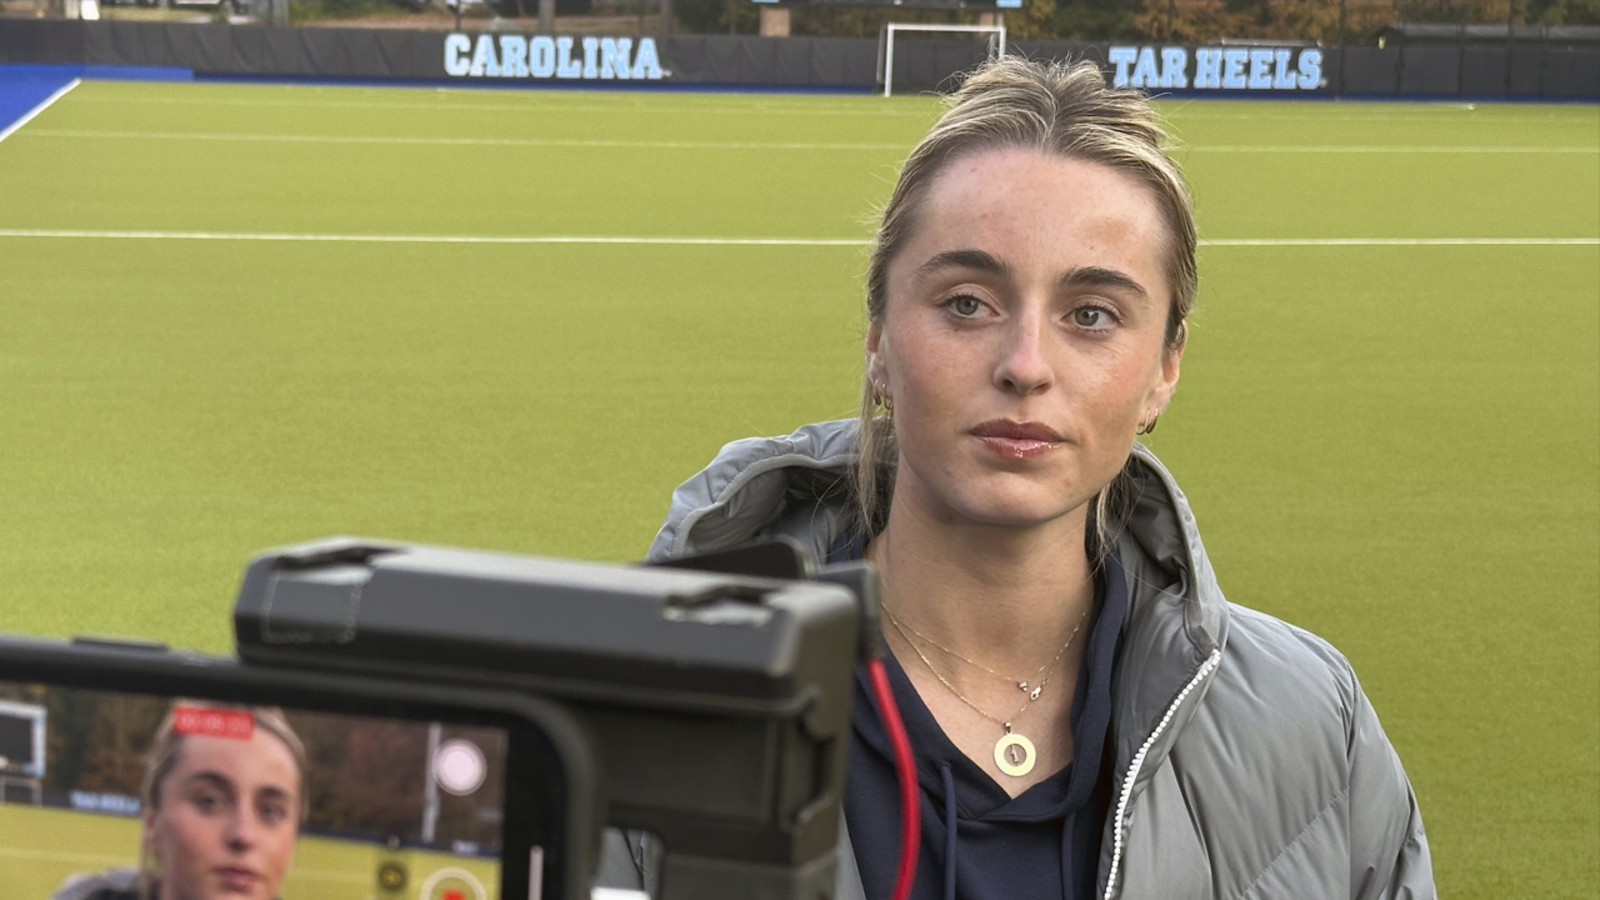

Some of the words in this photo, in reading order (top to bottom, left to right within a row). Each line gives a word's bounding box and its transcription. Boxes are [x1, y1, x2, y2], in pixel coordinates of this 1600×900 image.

[444, 33, 663, 79] CAROLINA
[1109, 46, 1188, 88] TAR
[1193, 48, 1323, 90] HEELS
